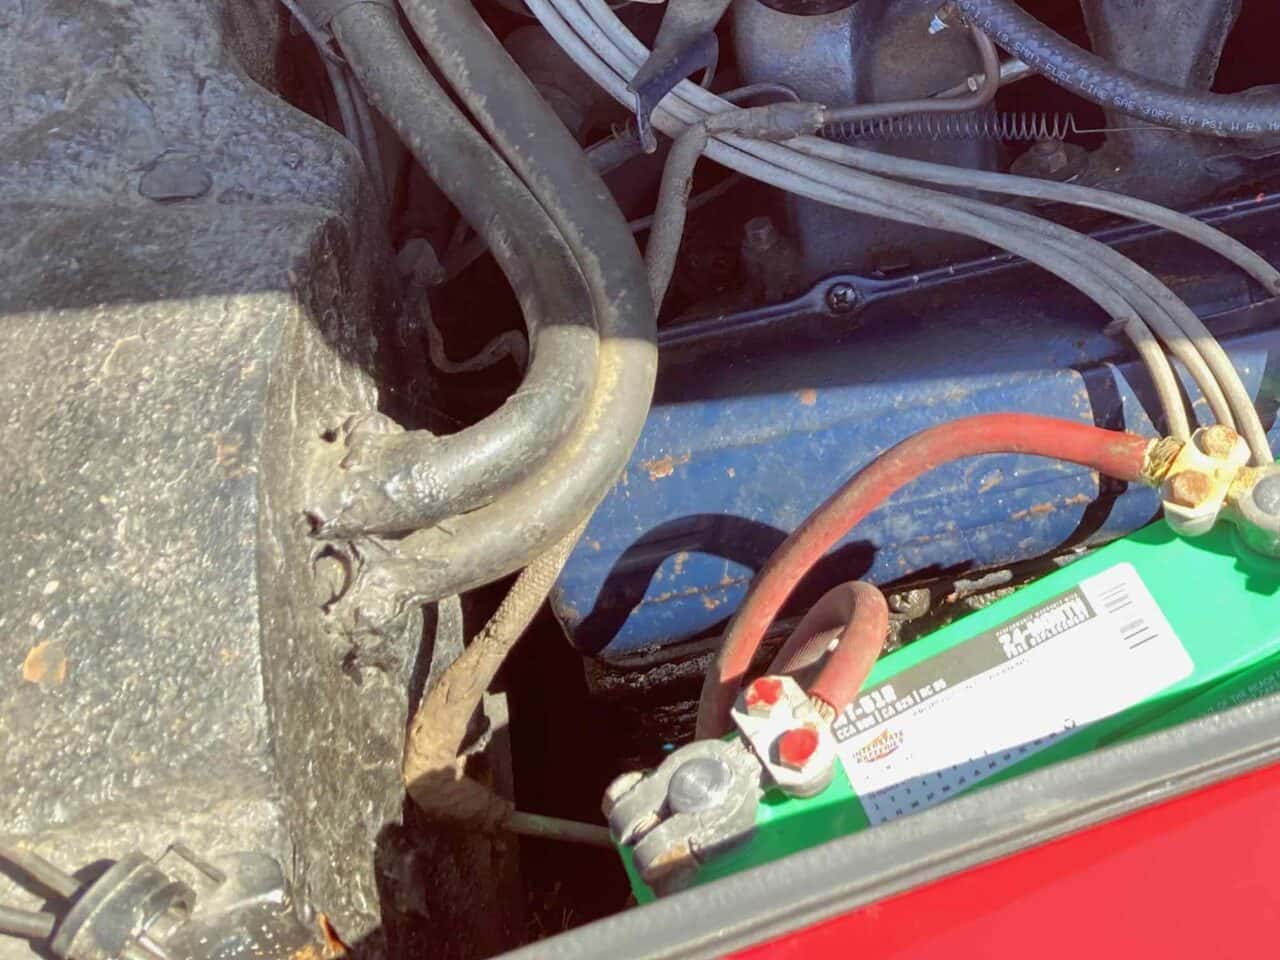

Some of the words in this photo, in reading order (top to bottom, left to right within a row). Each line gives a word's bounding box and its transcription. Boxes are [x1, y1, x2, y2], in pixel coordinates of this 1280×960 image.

[1044, 63, 1074, 84] FUEL
[1080, 80, 1107, 102] LINE
[1112, 95, 1137, 112] SAE
[1200, 118, 1223, 130] PSI
